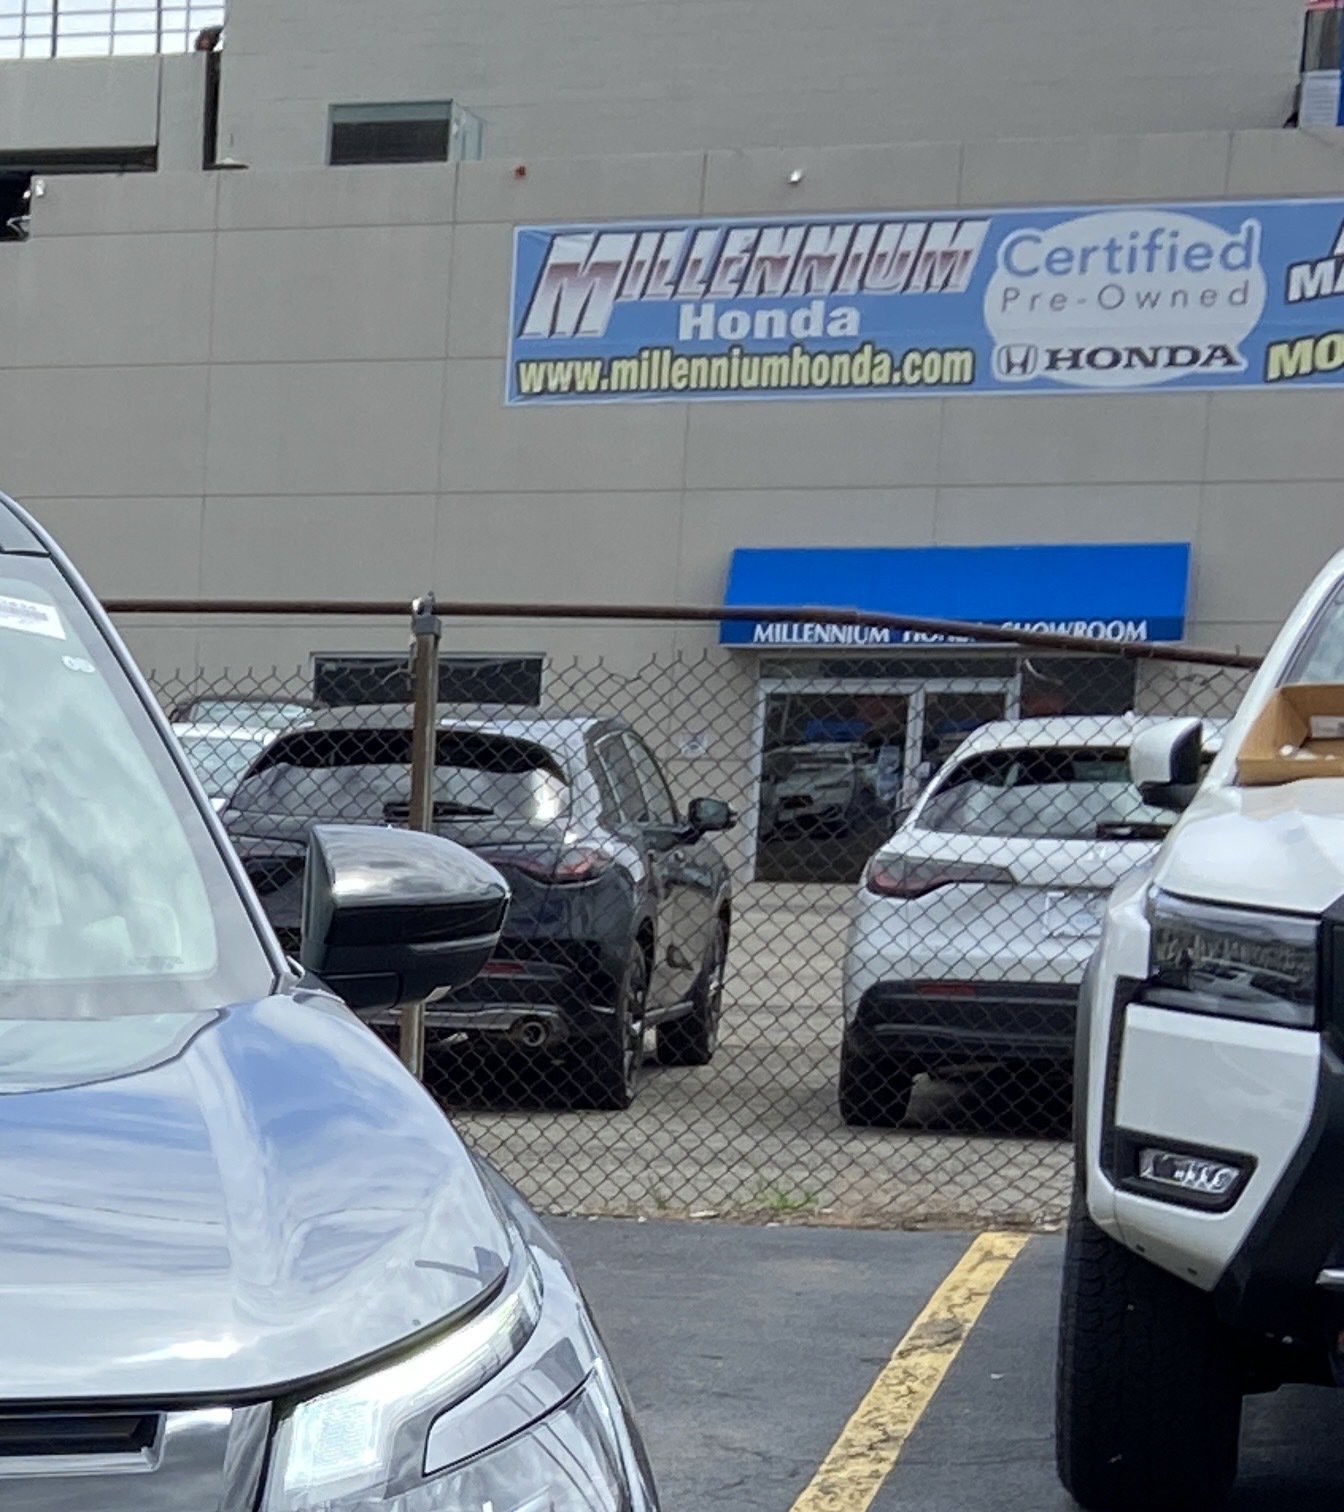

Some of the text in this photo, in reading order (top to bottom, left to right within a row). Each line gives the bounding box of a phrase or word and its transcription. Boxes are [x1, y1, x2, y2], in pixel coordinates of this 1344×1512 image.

[1003, 225, 1253, 277] Certified
[1001, 280, 1249, 313] Pre-Owned
[678, 300, 860, 341] Honda
[518, 343, 974, 393] www.millenniumhonda.com
[1044, 344, 1242, 370] HONDA
[753, 623, 890, 643] MILLENNIUM
